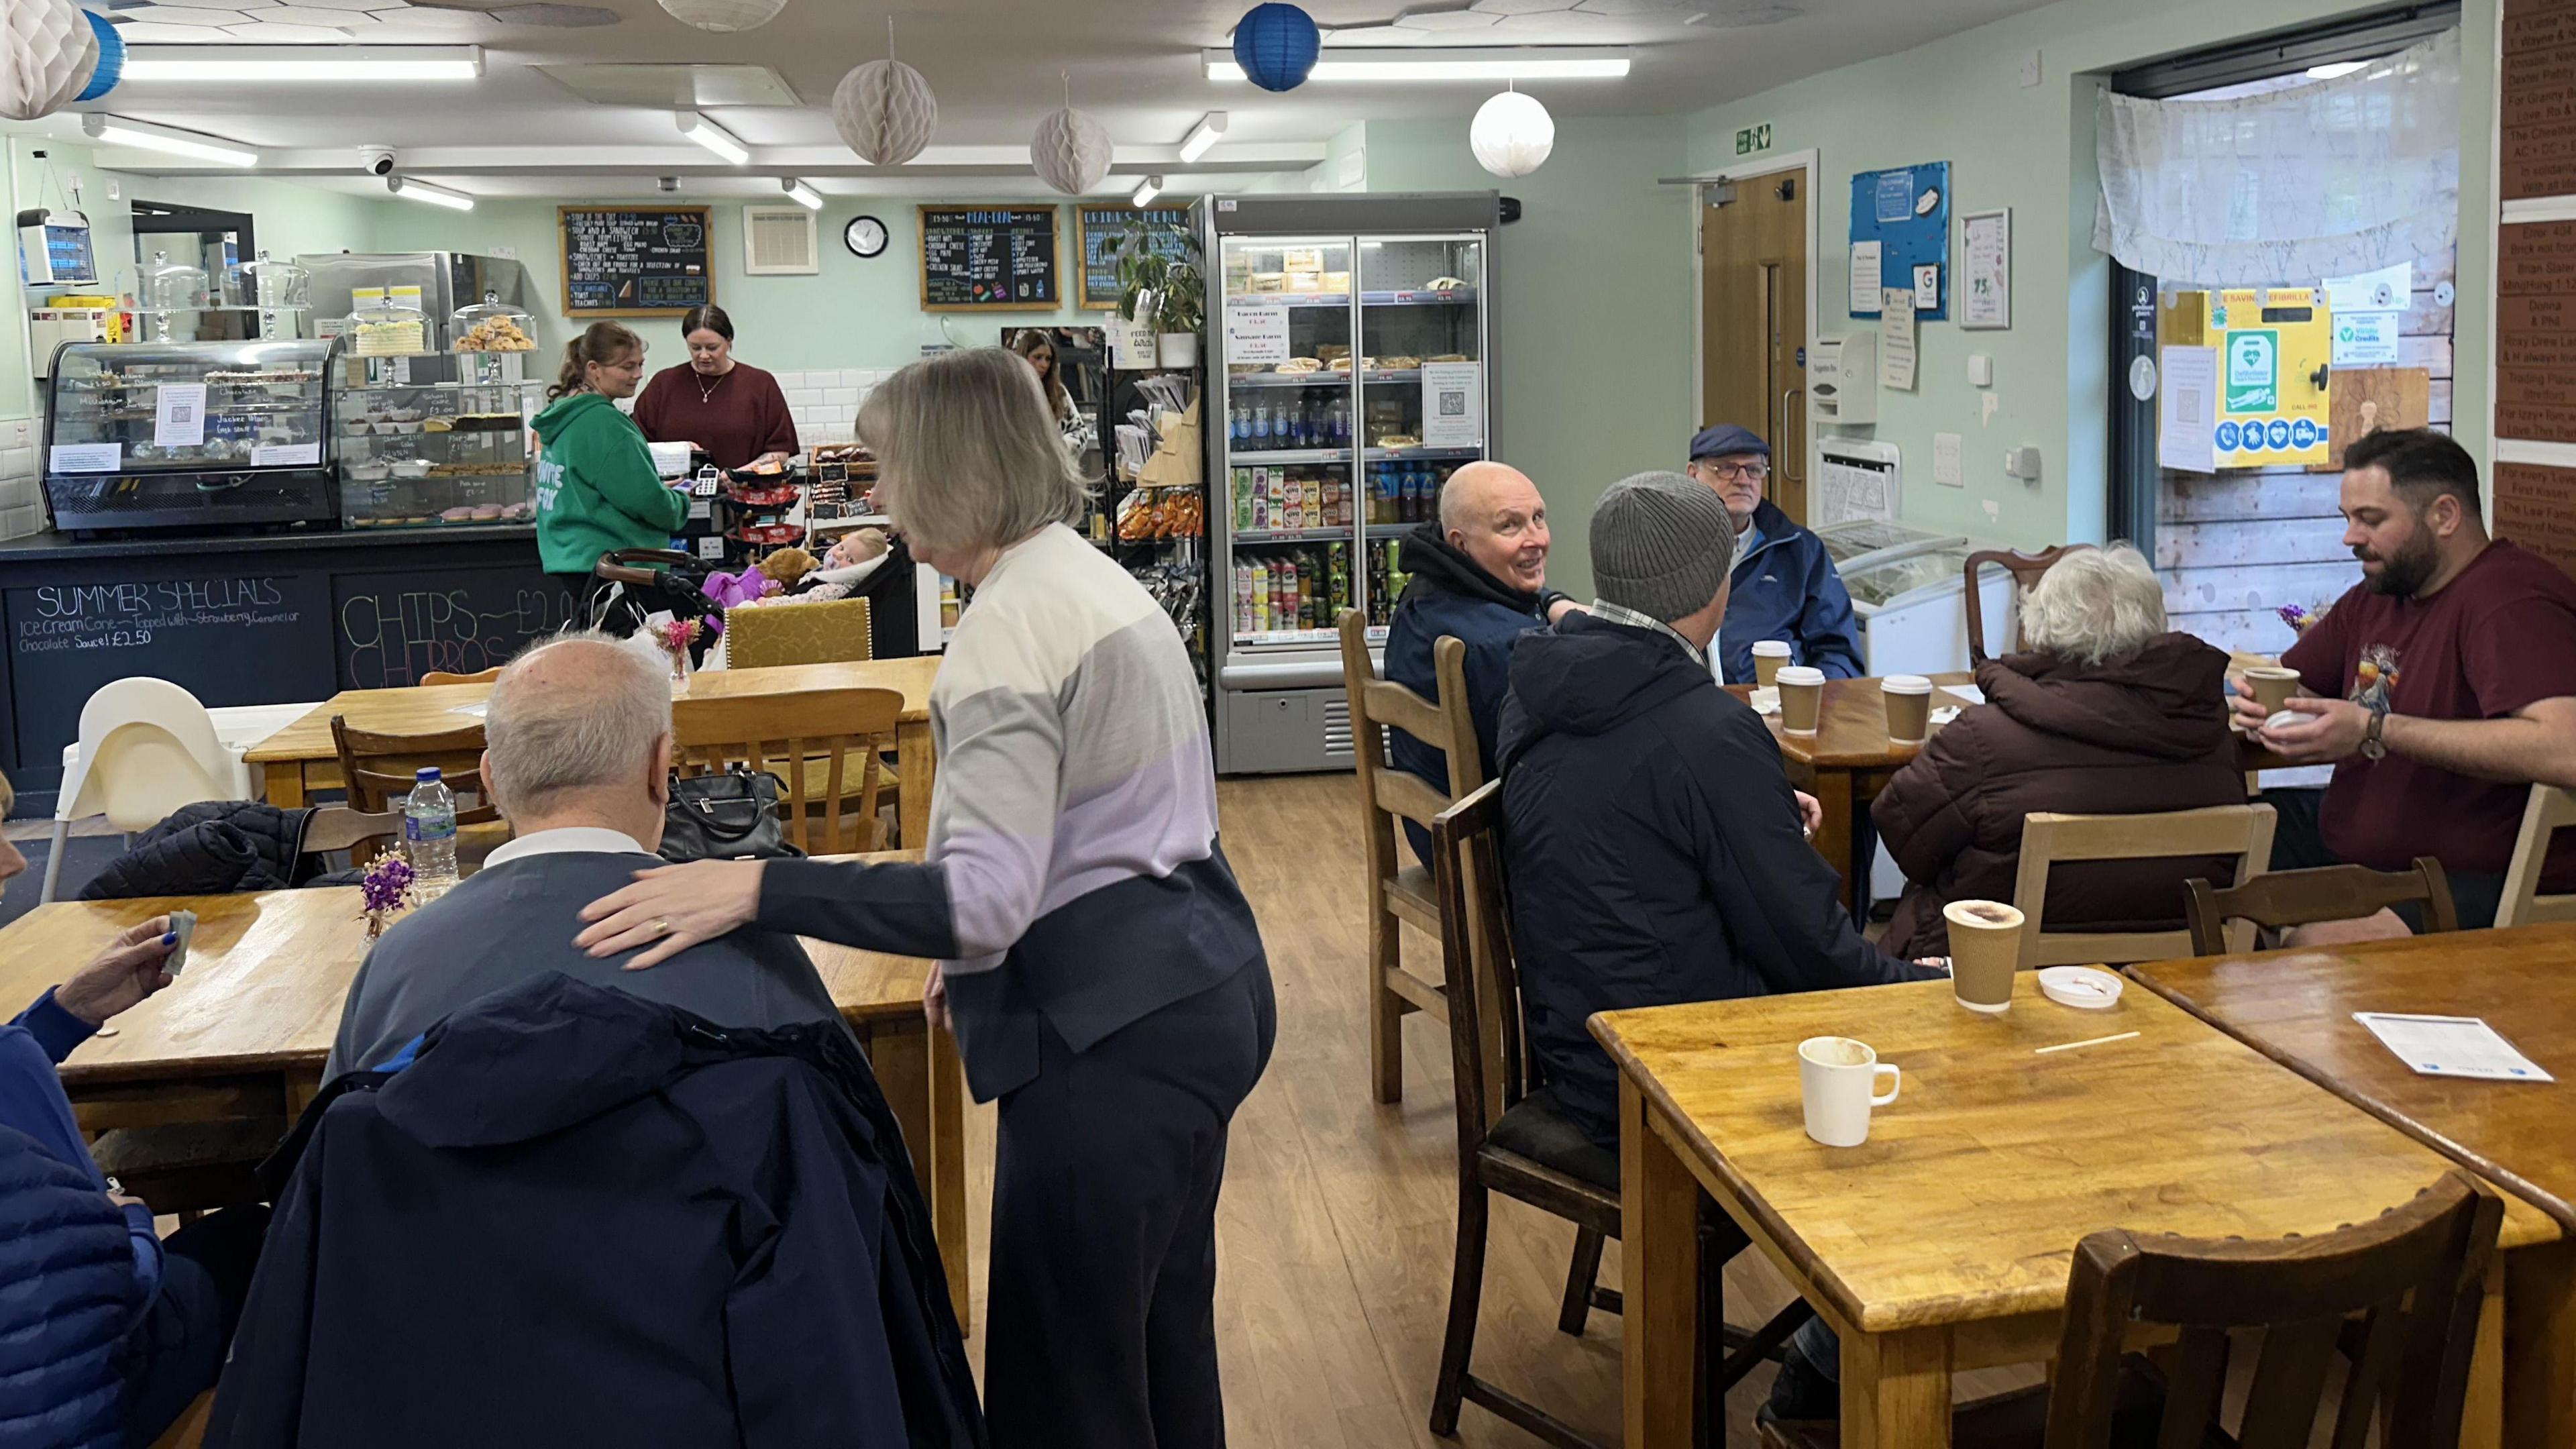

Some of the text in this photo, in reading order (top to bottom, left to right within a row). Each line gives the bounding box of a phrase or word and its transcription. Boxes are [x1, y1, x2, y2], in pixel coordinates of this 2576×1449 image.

[2511, 129, 2528, 142] The
[2514, 142, 2557, 158] AC DC
[606, 212, 616, 221] DAY
[967, 211, 1012, 224] MEAL DEAL
[1084, 210, 1181, 224] DRINKS MENU
[588, 227, 600, 235] AND
[609, 226, 639, 235] SANDWICH
[2522, 225, 2572, 240] Error 404
[2510, 241, 2553, 256] Brick not
[929, 263, 949, 272] CHICKEN
[573, 272, 584, 281] ADD
[574, 291, 589, 299] TOAST
[2231, 294, 2255, 303] SAVIN
[2269, 292, 2310, 302] EFIBRILLA
[2529, 299, 2562, 313] Donna
[2530, 315, 2538, 327] &
[1130, 329, 1147, 338] FEED
[2508, 372, 2544, 387] Trading
[537, 486, 558, 512] FOX
[2503, 500, 2521, 515] The
[37, 577, 281, 617] SUMMER SPECIALS
[42, 619, 84, 635] Cream
[85, 616, 116, 633] Cone
[133, 613, 166, 631] Topped
[343, 588, 478, 647] CHIPS
[19, 629, 152, 653] Chocolate Sauce! £2.50
